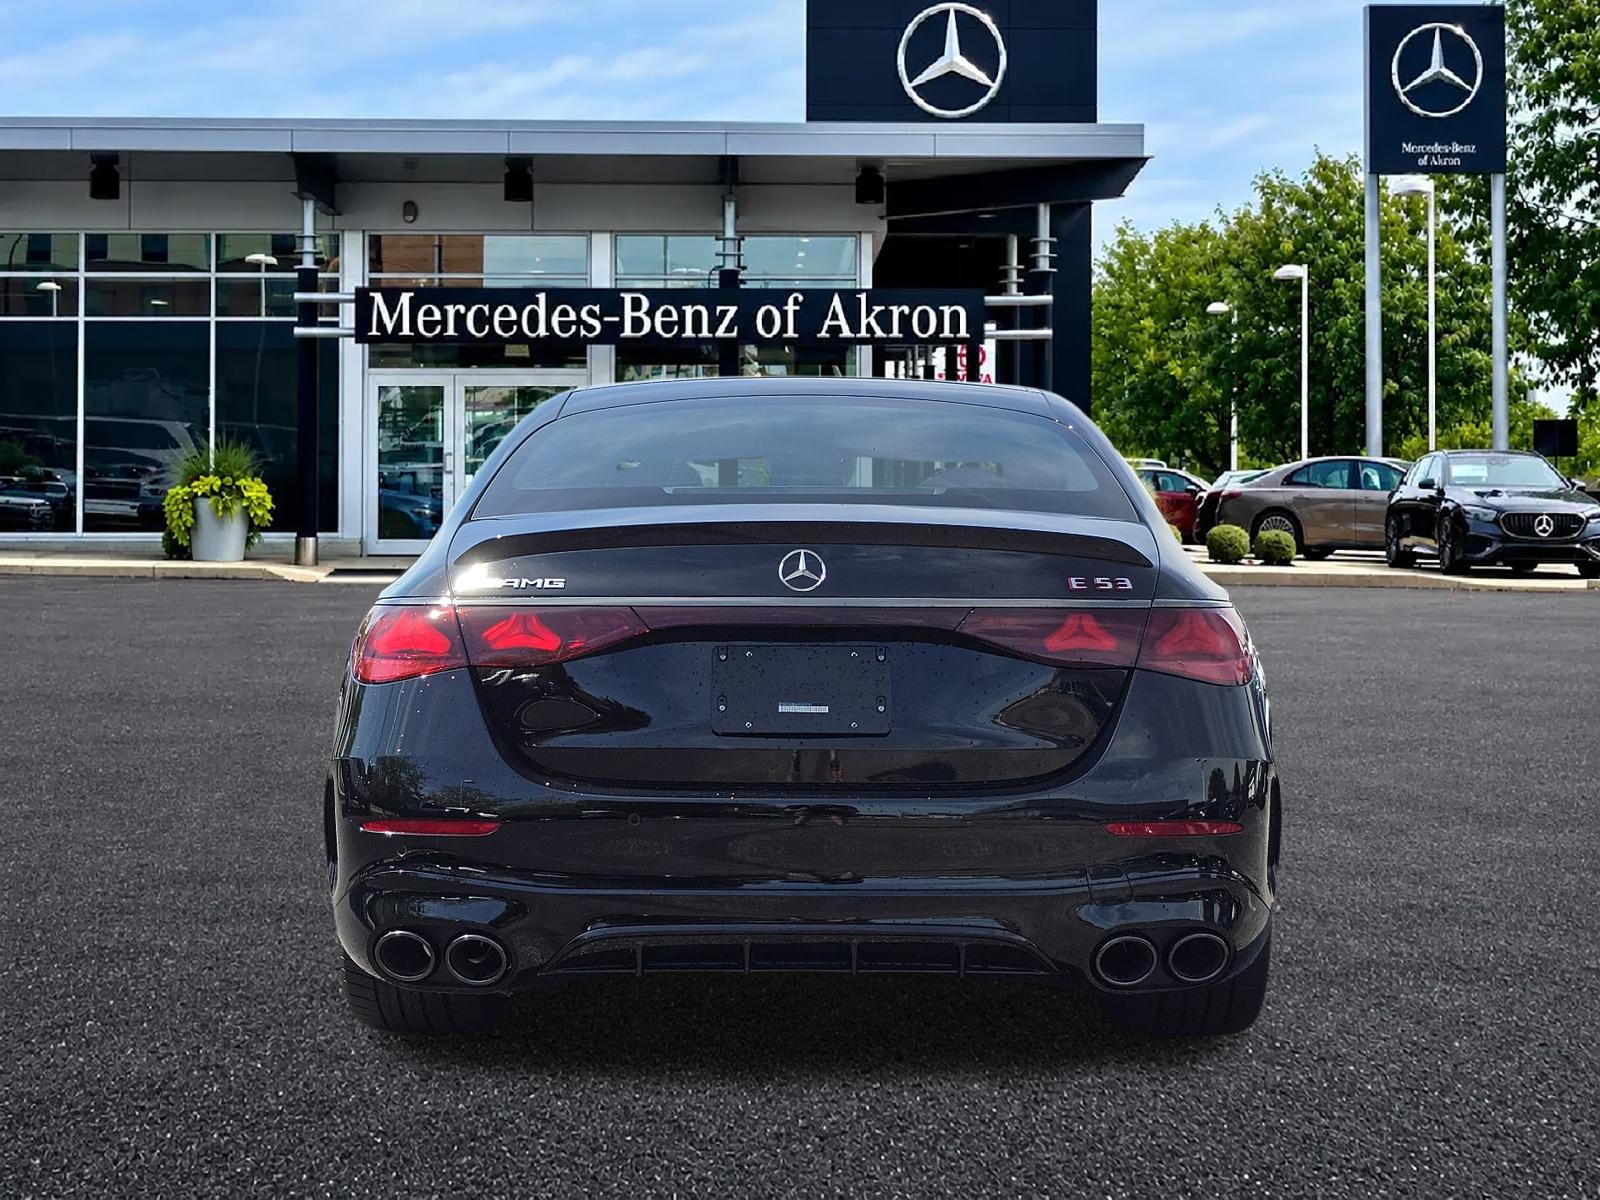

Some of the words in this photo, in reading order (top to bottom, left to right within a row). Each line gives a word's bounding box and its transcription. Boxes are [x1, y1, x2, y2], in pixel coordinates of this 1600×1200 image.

[1417, 154, 1429, 166] of
[1430, 154, 1461, 166] Akron
[367, 291, 739, 339] Mercedes-Benz
[755, 291, 804, 339] of
[816, 291, 971, 339] Akron
[499, 577, 567, 590] AMG
[1067, 576, 1088, 591] E
[1093, 576, 1134, 591] 53
